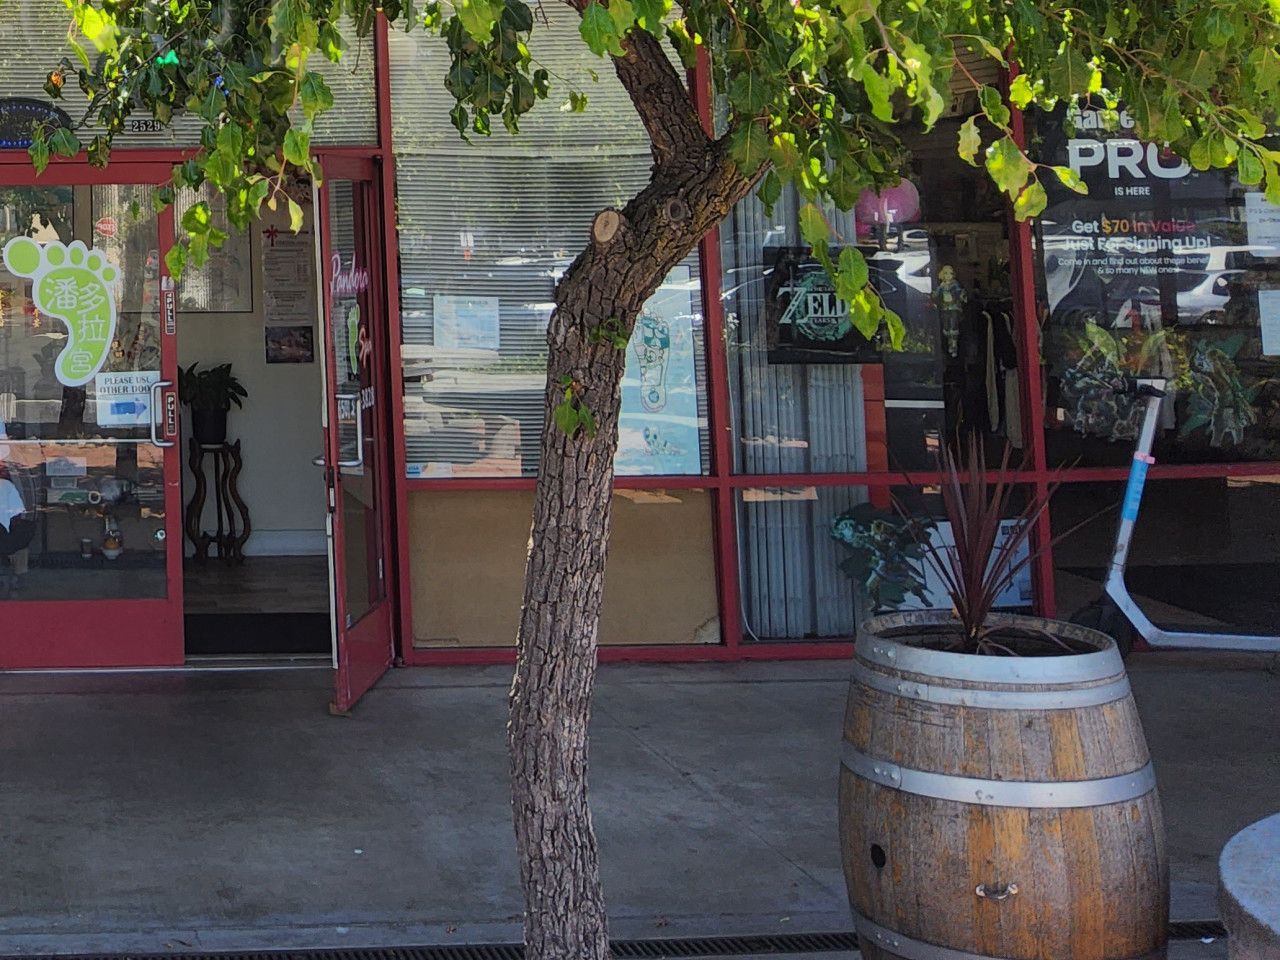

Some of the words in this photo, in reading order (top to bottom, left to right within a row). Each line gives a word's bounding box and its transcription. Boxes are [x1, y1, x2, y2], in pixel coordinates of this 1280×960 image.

[132, 120, 162, 133] 2529
[1114, 187, 1124, 196] IS
[1126, 186, 1151, 196] HERE
[1072, 220, 1099, 234] Get
[1102, 218, 1130, 234] $70
[1123, 235, 1181, 253] Signing
[1185, 235, 1211, 249] Up!
[777, 286, 850, 324] ZELD
[104, 376, 134, 385] PLEASE
[99, 385, 129, 394] OTHER
[131, 384, 151, 394] DOO
